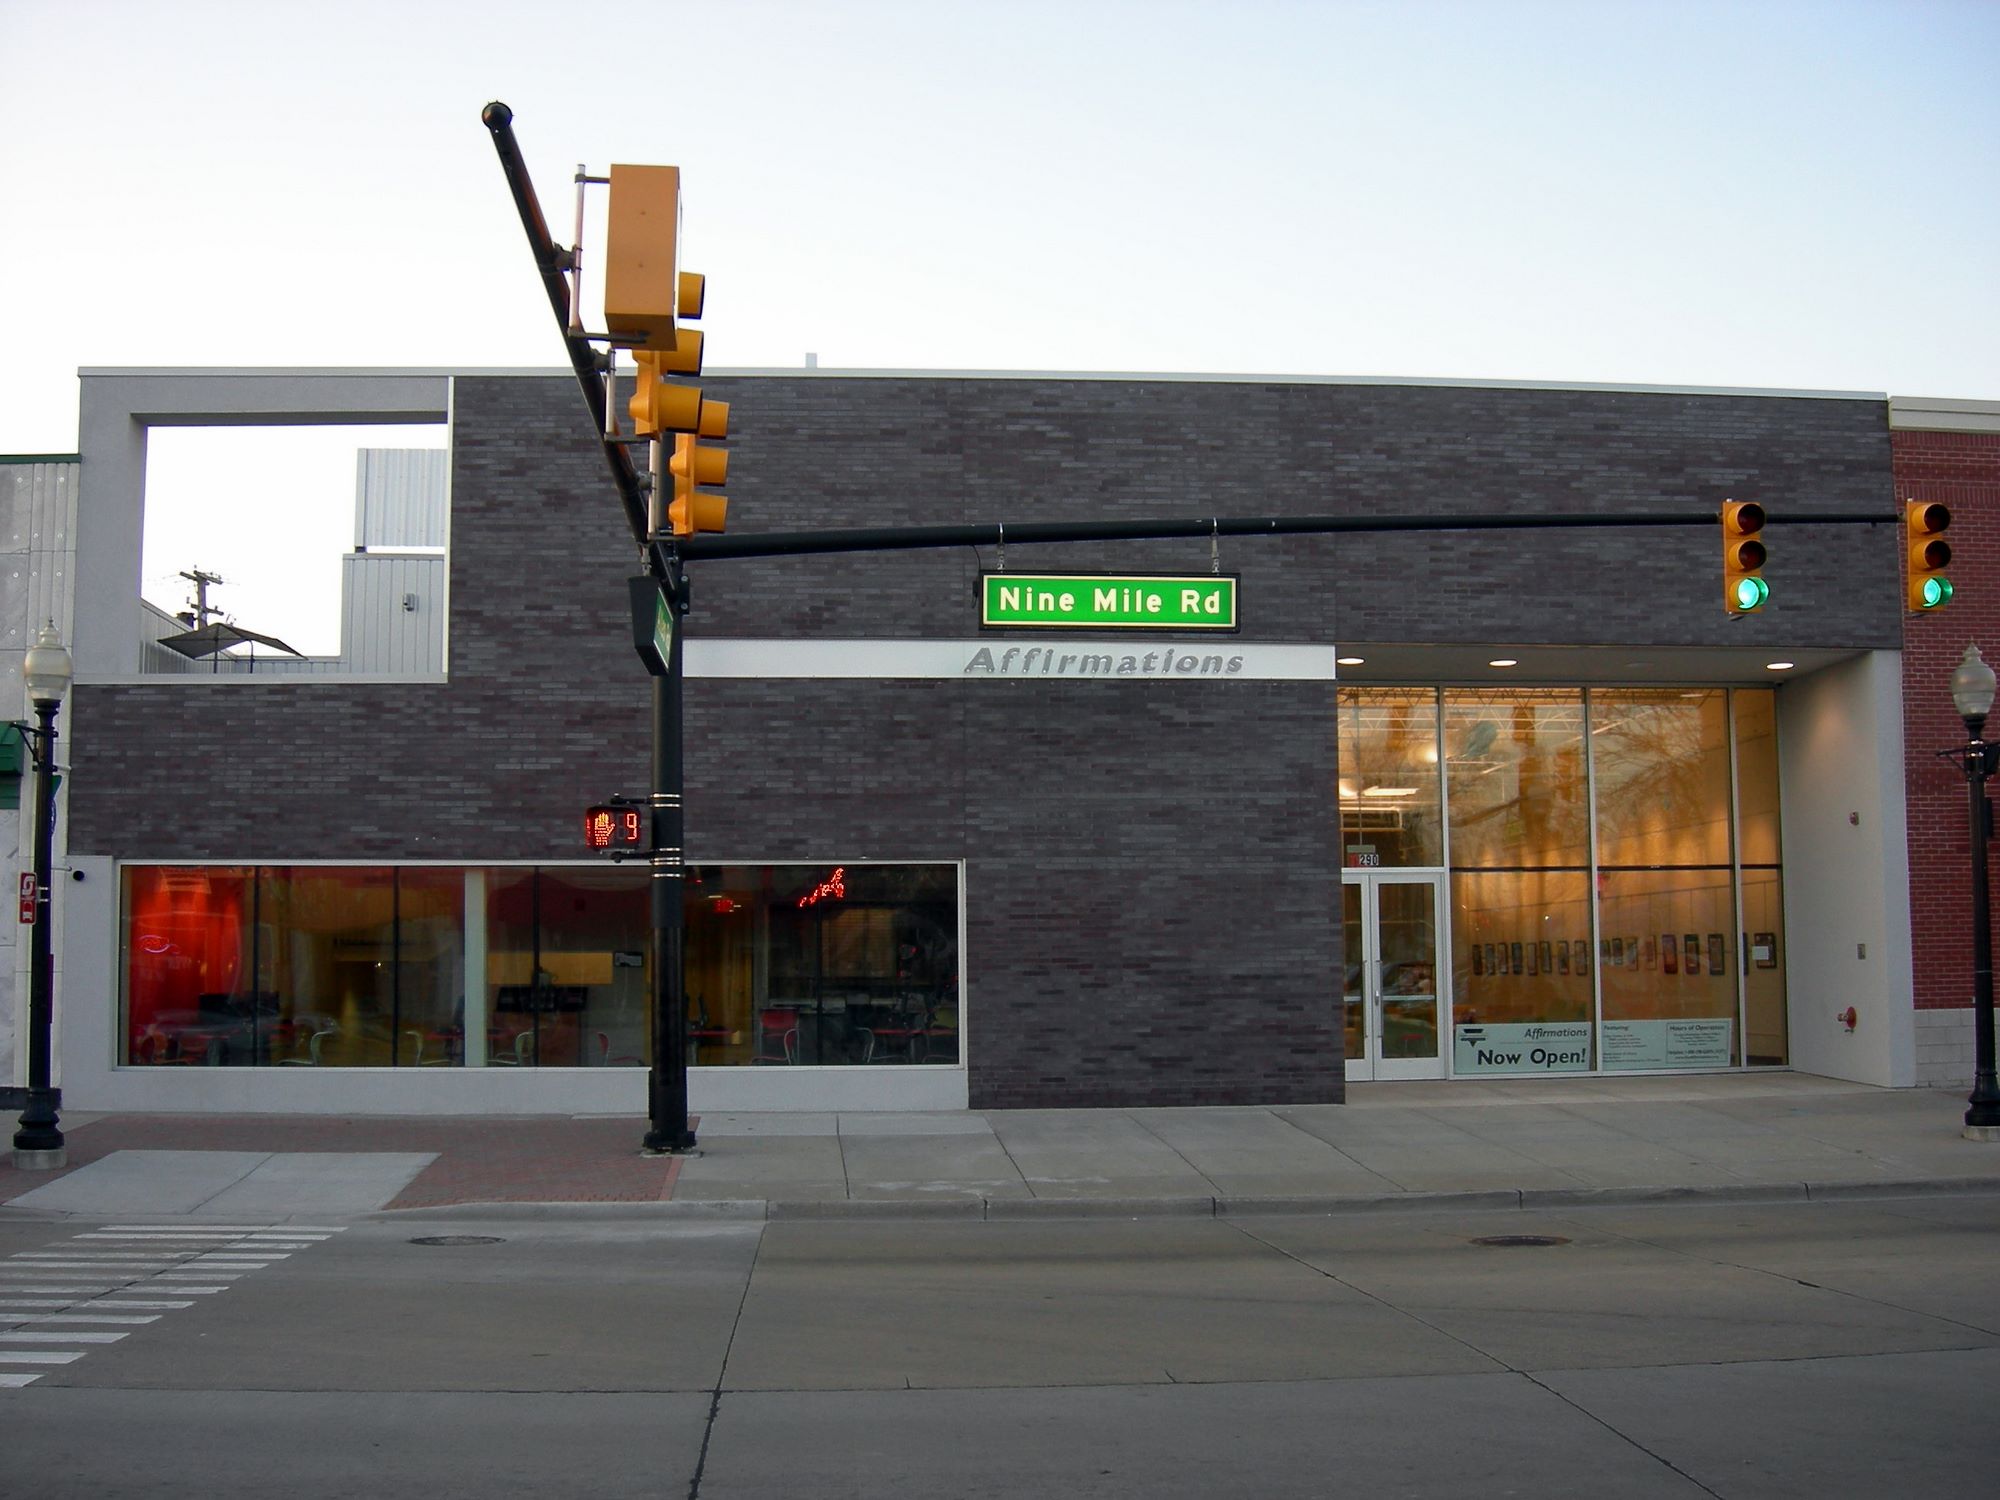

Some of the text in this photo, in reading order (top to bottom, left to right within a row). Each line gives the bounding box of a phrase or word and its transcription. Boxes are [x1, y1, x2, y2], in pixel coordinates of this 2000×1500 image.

[999, 585, 1221, 614] Nine Mile Rd
[964, 647, 1244, 674] Affirmations
[626, 813, 638, 840] 9
[1360, 854, 1378, 866] 290
[1524, 1027, 1588, 1040] Affirmations
[1477, 1049, 1522, 1066] Now
[1530, 1047, 1587, 1069] Open!
